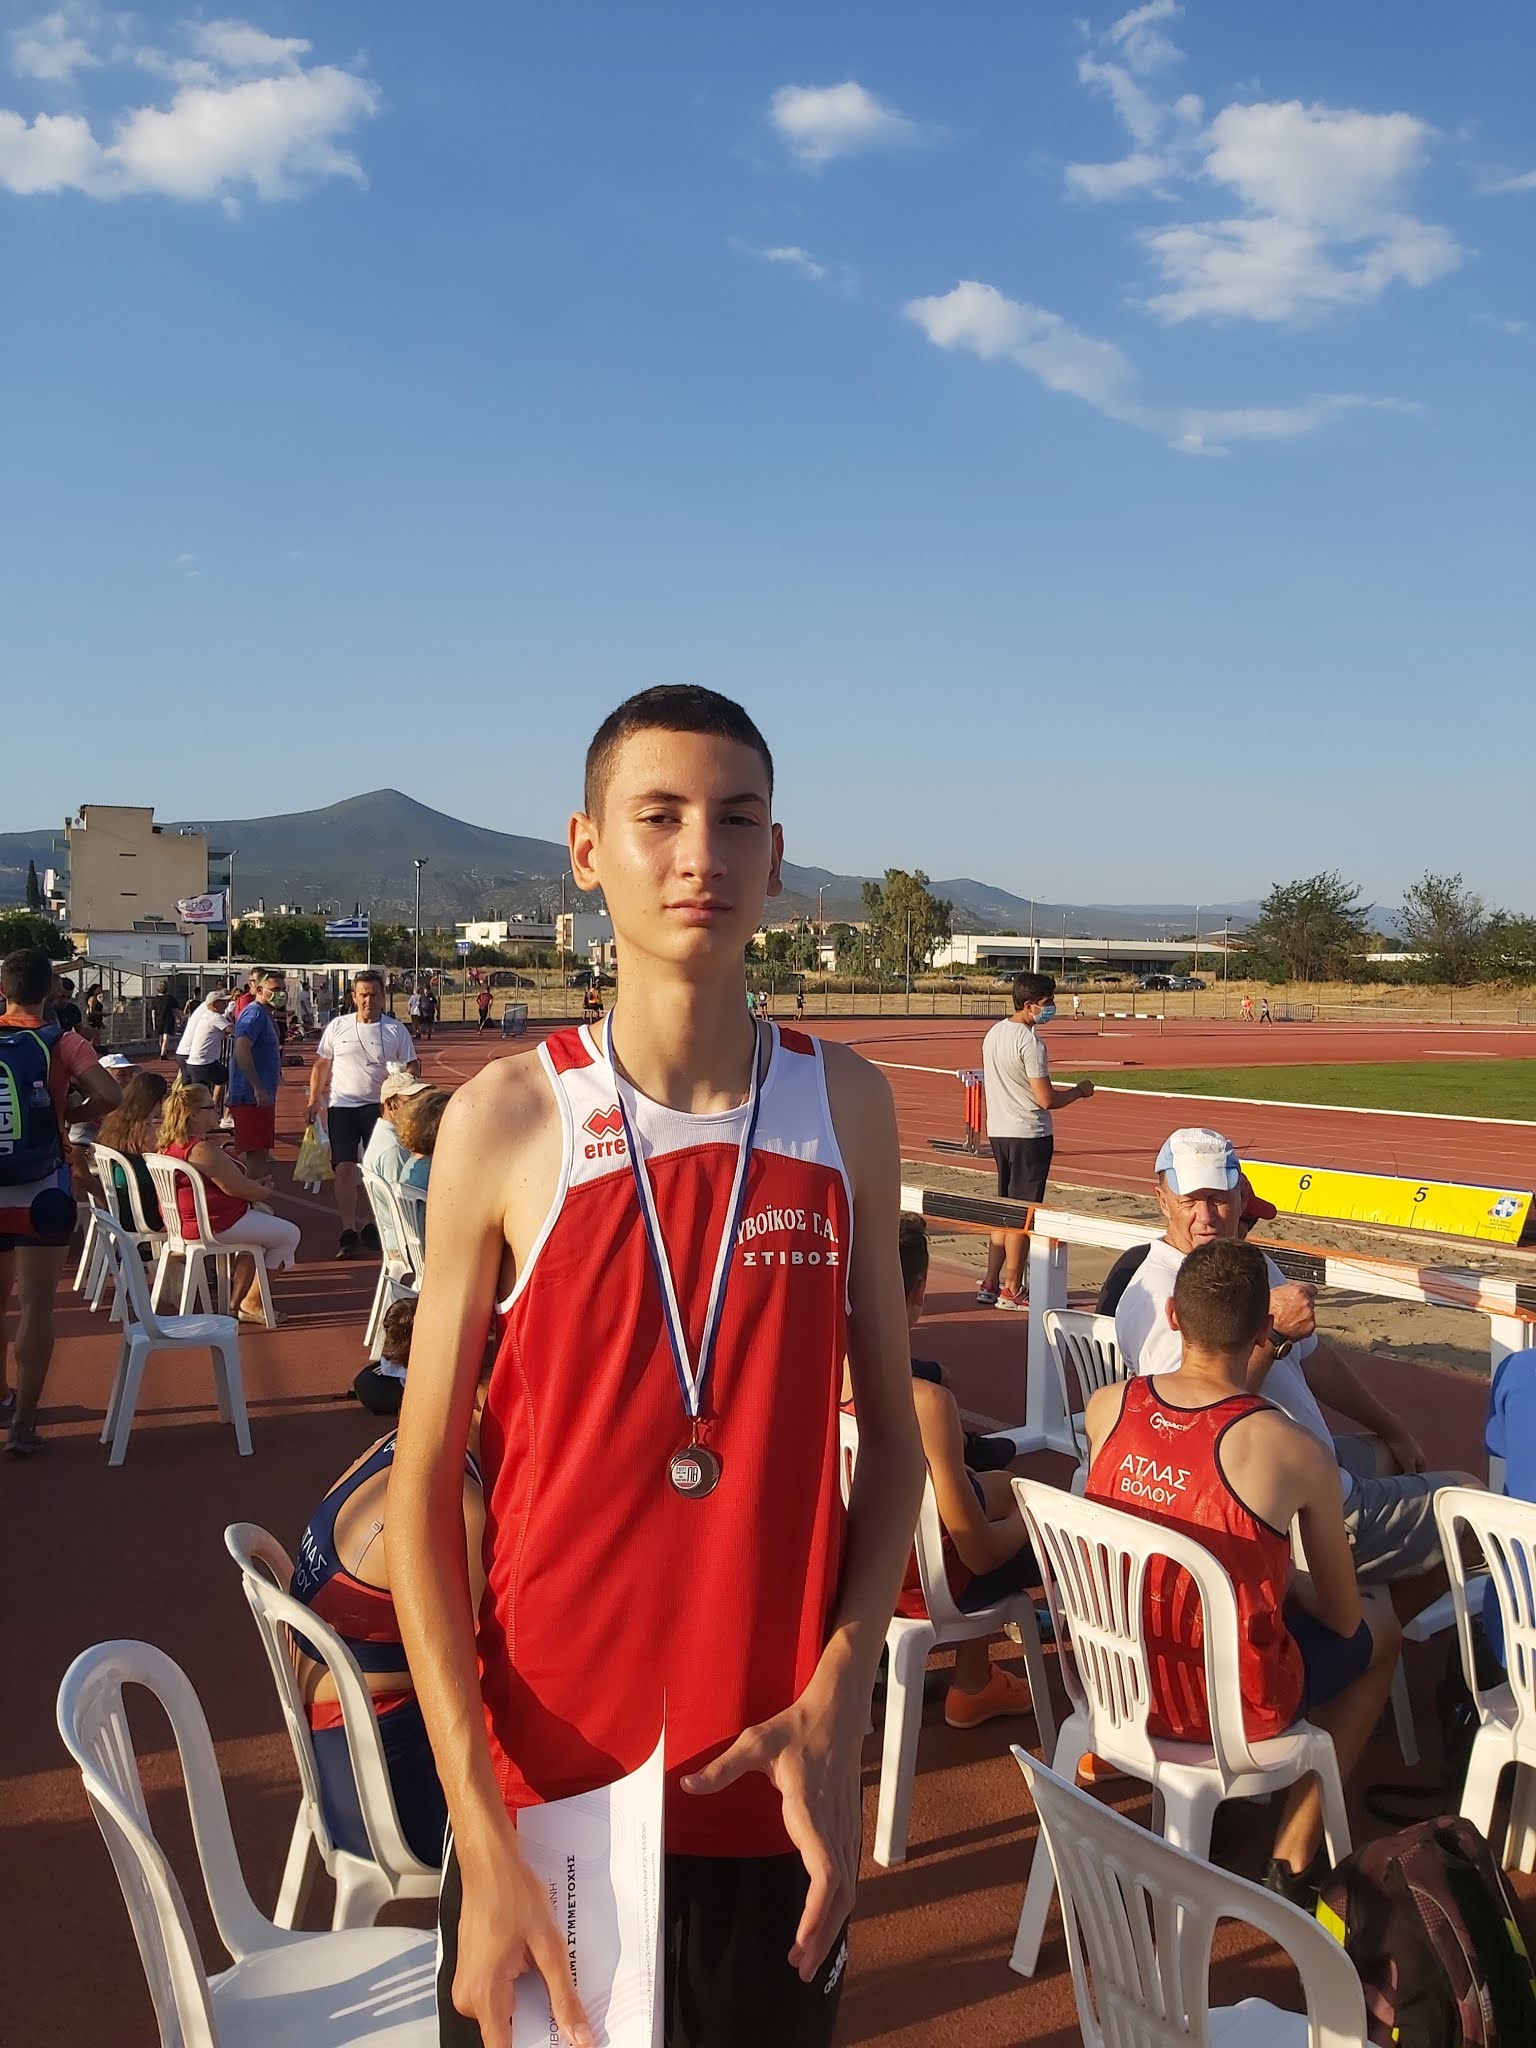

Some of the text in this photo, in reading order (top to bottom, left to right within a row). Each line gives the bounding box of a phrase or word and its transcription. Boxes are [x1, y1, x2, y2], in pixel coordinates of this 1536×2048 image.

[584, 1138, 627, 1160] erre
[1298, 1174, 1312, 1190] 6
[1413, 1186, 1429, 1203] 5
[733, 1204, 806, 1248] ΥΒΟΪΚΟΣ
[743, 1251, 840, 1266] ΣΤΙΒΟΣ
[1119, 1454, 1190, 1490] ΑΤΛΑΣ
[1120, 1477, 1177, 1506] ΒΟΛΟΥ
[301, 1526, 328, 1582] ΤΛΑΣ
[567, 1855, 576, 1945] ΣΥΜΜΕΤΟΧΗΣ
